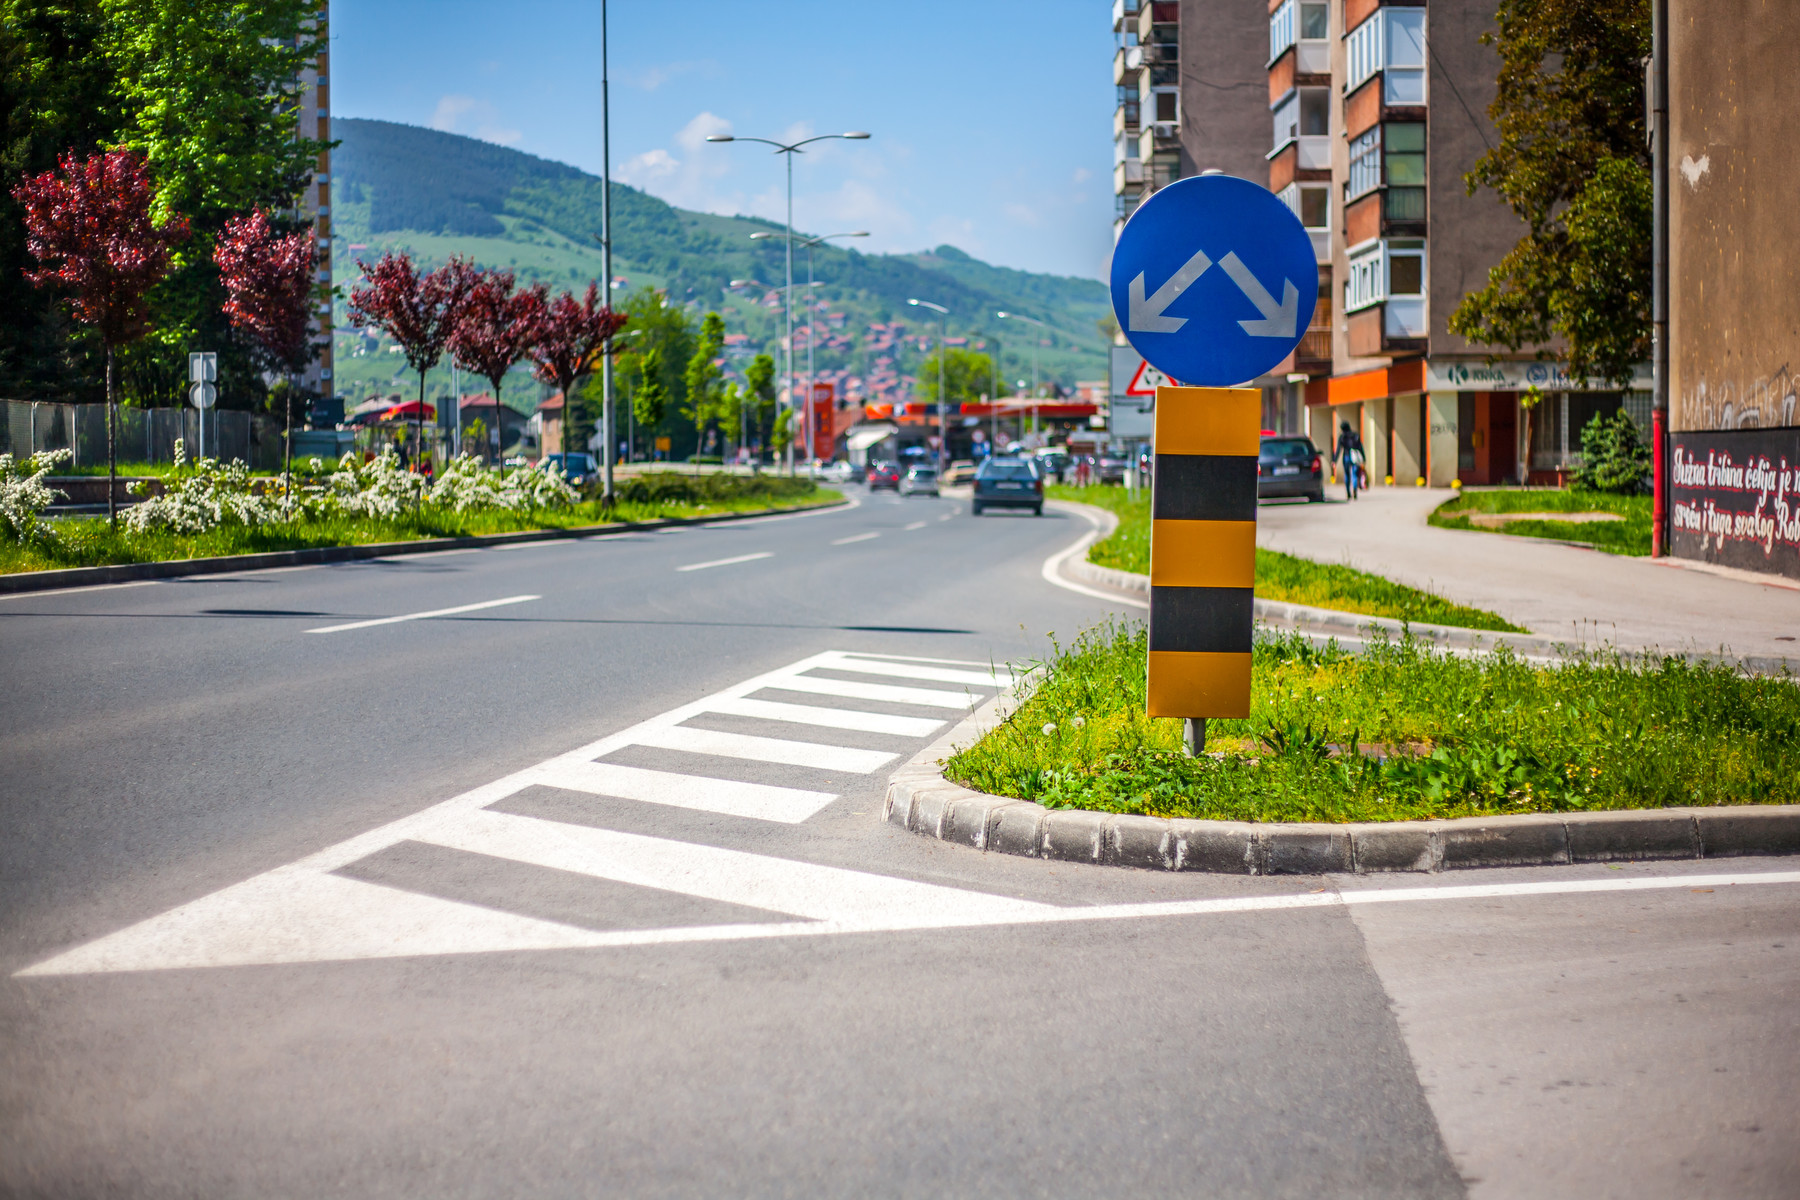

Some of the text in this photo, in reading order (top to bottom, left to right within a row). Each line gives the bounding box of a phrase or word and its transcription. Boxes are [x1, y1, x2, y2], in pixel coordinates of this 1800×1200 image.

[1707, 450, 1744, 489] tribina
[1774, 459, 1792, 511] je
[1702, 500, 1708, 532] i
[1708, 501, 1733, 550] tuga
